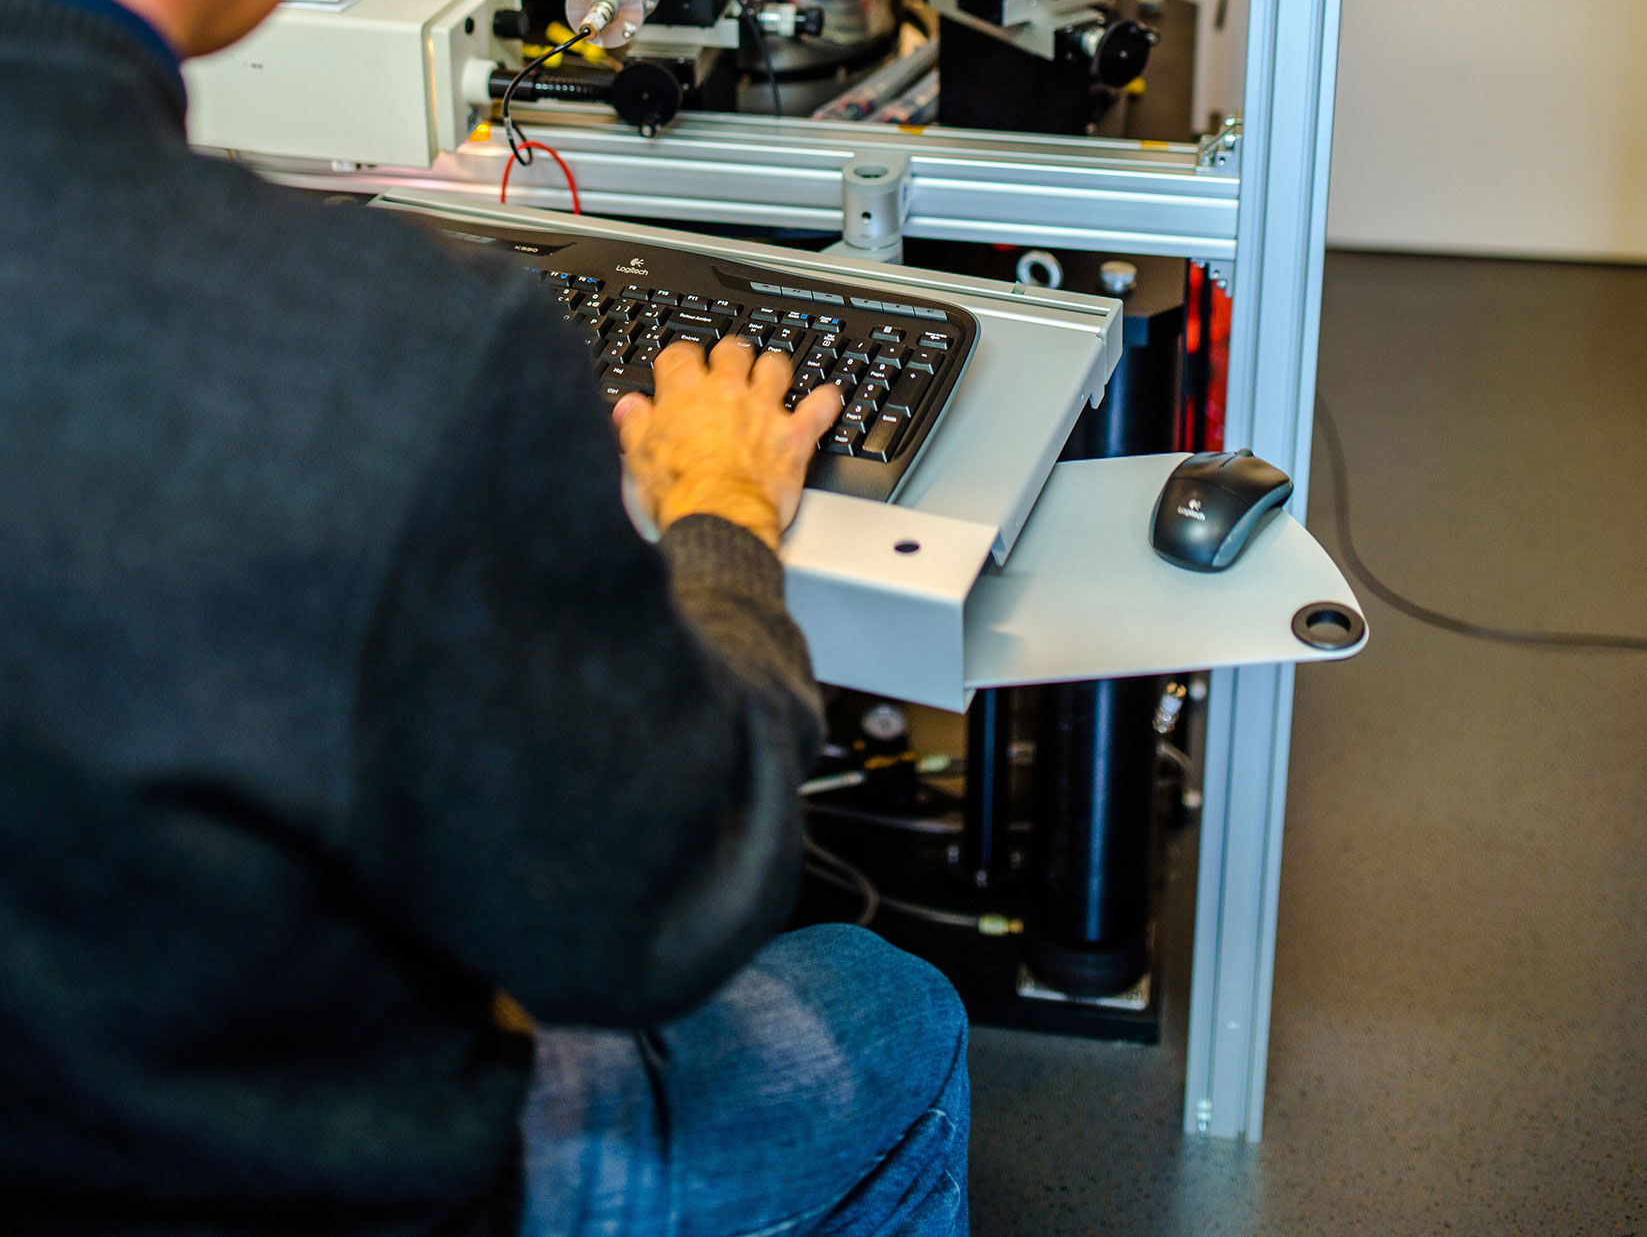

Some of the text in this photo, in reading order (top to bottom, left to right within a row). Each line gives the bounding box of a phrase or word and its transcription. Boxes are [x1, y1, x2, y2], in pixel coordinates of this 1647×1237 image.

[615, 264, 649, 276] Logitech
[717, 299, 729, 307] F12
[606, 387, 619, 395] Ctrl
